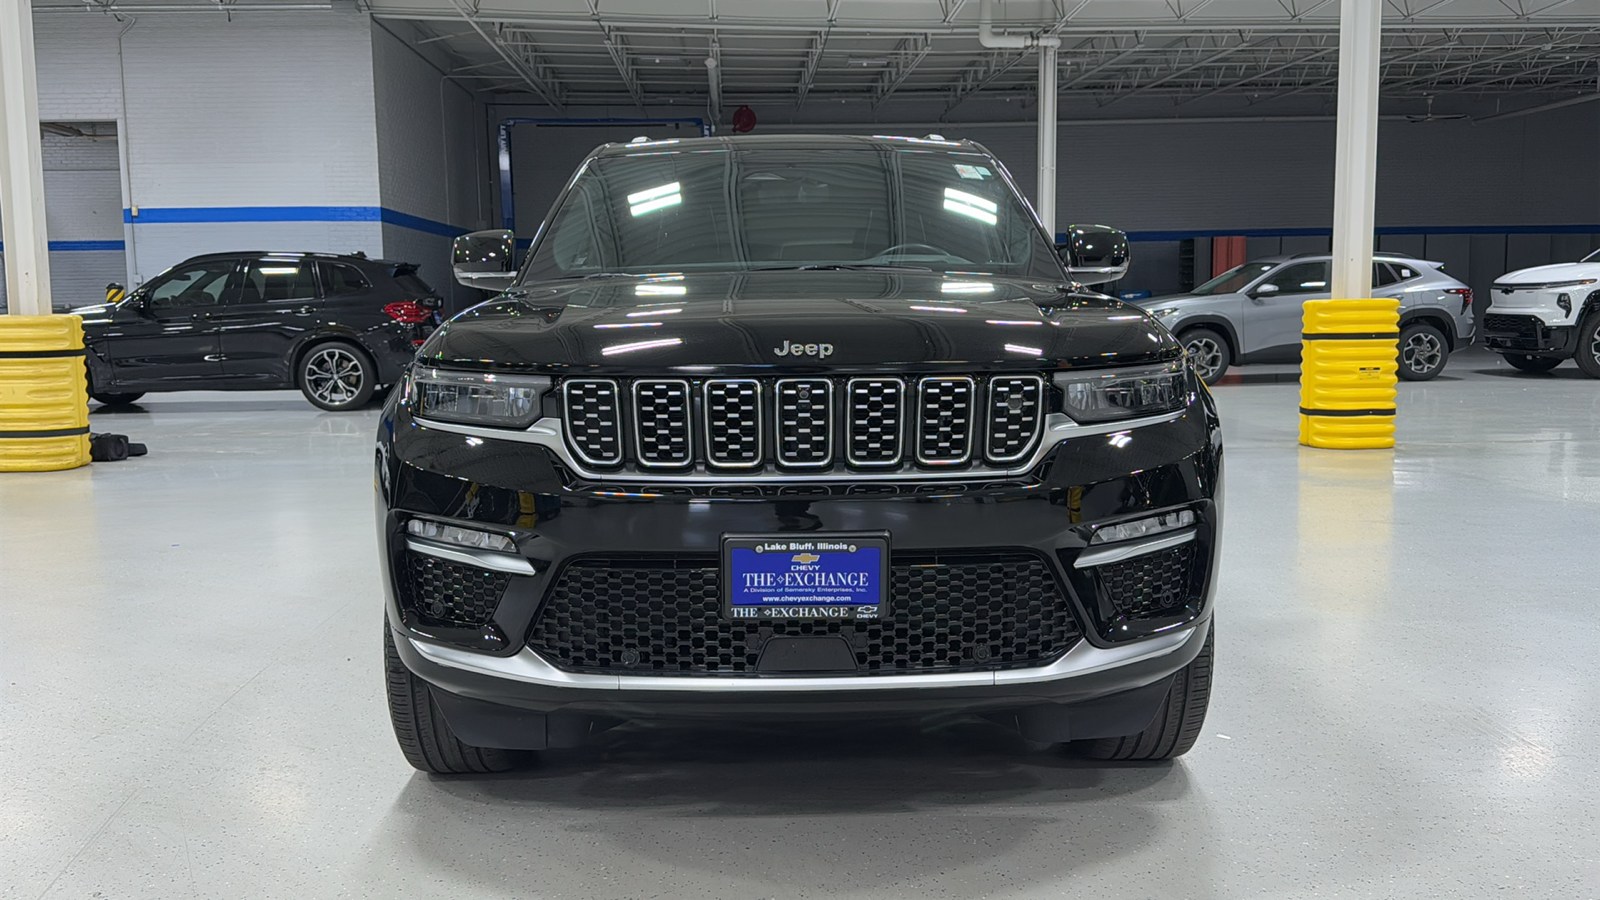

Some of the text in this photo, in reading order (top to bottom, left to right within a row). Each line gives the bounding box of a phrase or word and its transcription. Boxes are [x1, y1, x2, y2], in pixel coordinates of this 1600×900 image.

[773, 340, 834, 359] Jeep
[764, 543, 787, 551] Lake
[789, 543, 815, 551] Bluff,
[742, 572, 869, 587] THE EXCHANGE
[762, 595, 852, 603] www.chevyexchange.com
[731, 607, 849, 618] THE EXCHANGE
